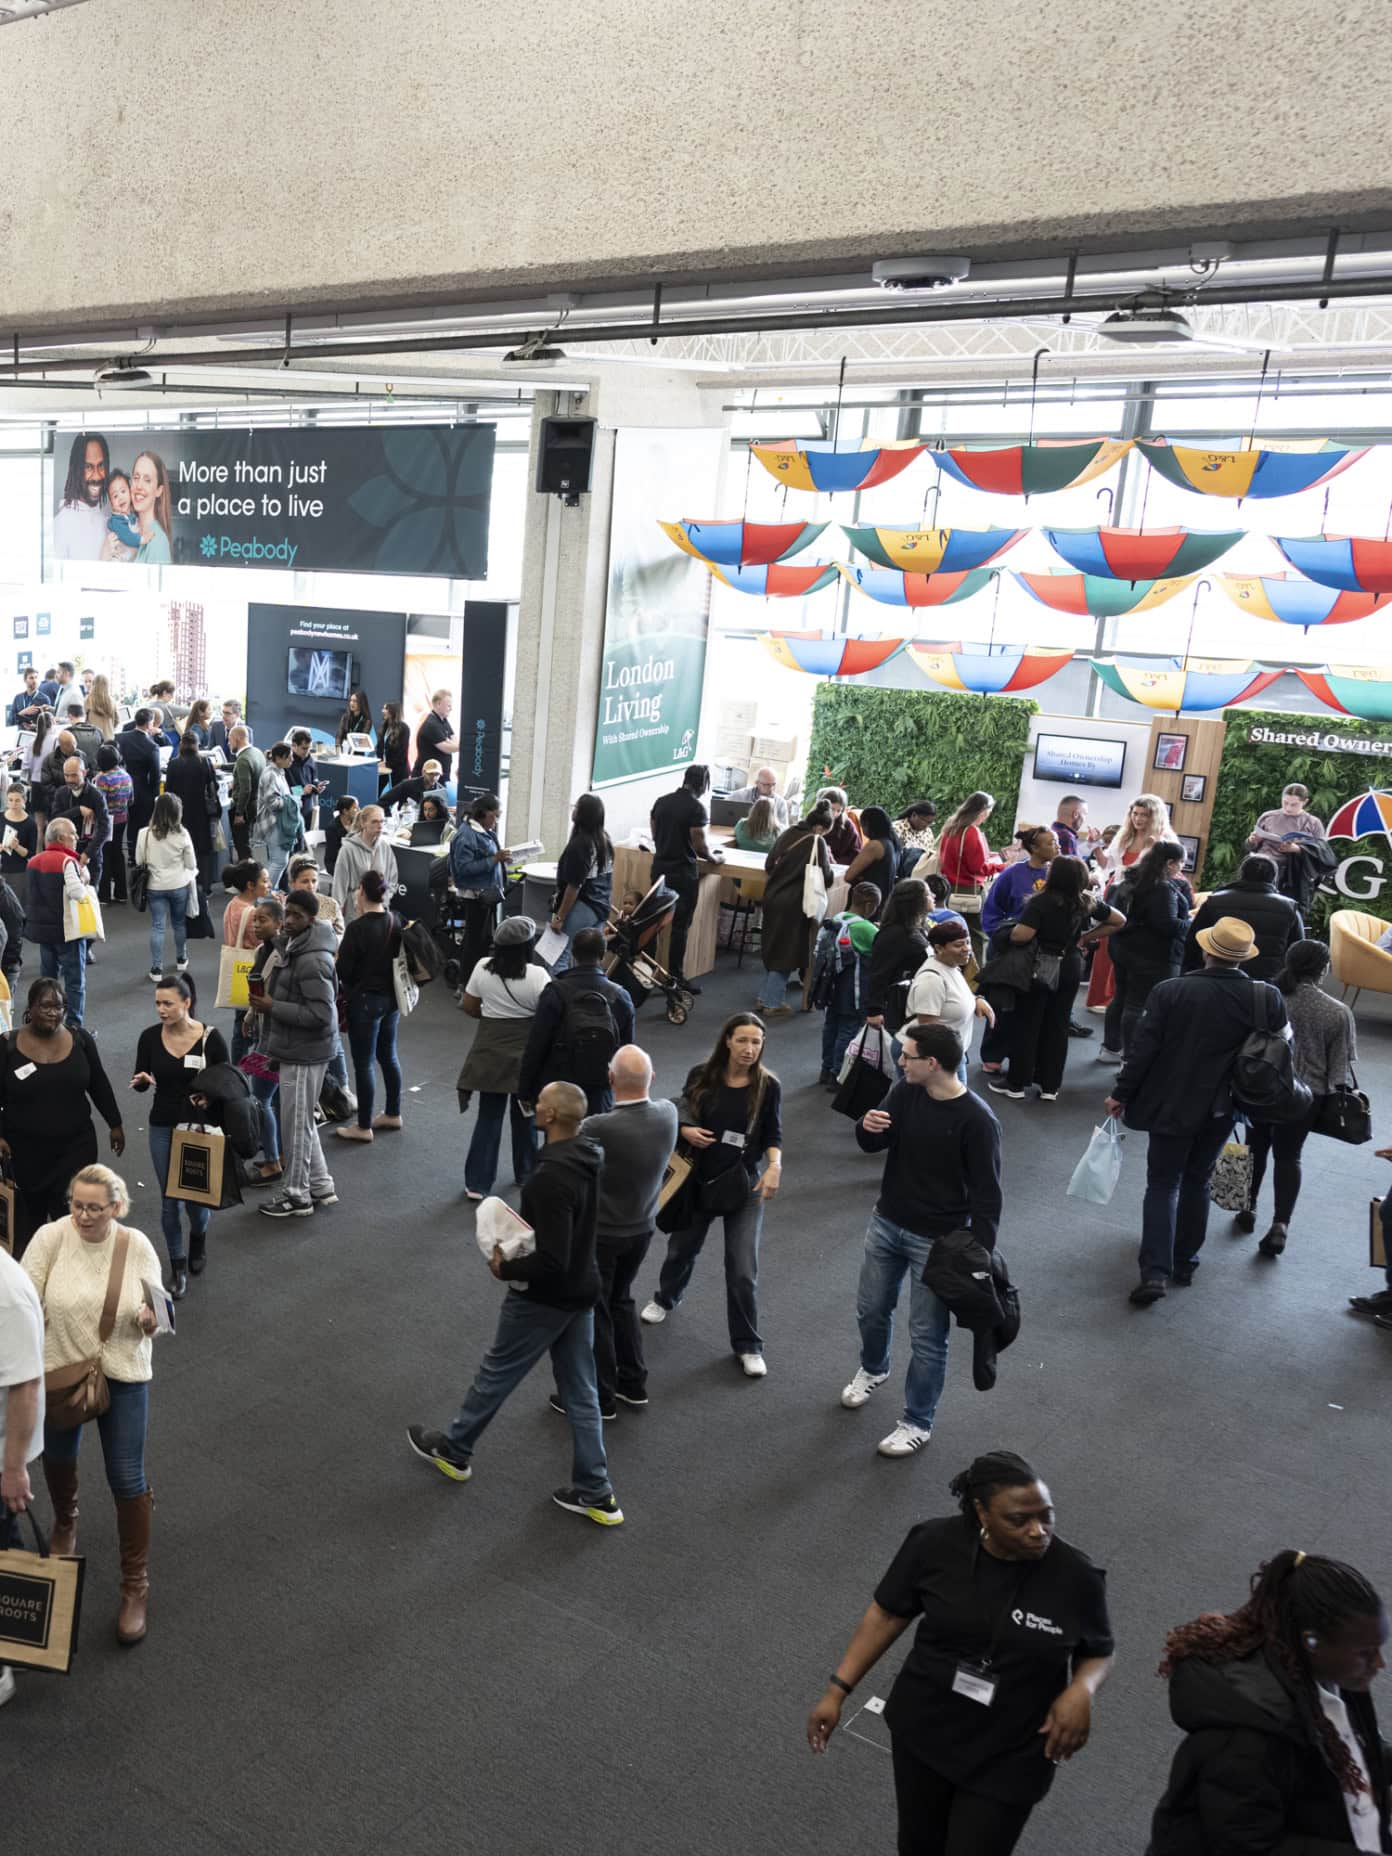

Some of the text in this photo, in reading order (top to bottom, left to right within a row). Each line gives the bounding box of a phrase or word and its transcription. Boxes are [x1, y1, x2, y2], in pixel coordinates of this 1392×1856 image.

[179, 460, 327, 488] More than just
[177, 493, 324, 520] a place to live
[220, 535, 298, 568] Peabody
[605, 655, 675, 690] London
[602, 691, 663, 725] Living
[672, 746, 689, 760] L&G
[1250, 727, 1392, 753] Shared Owner
